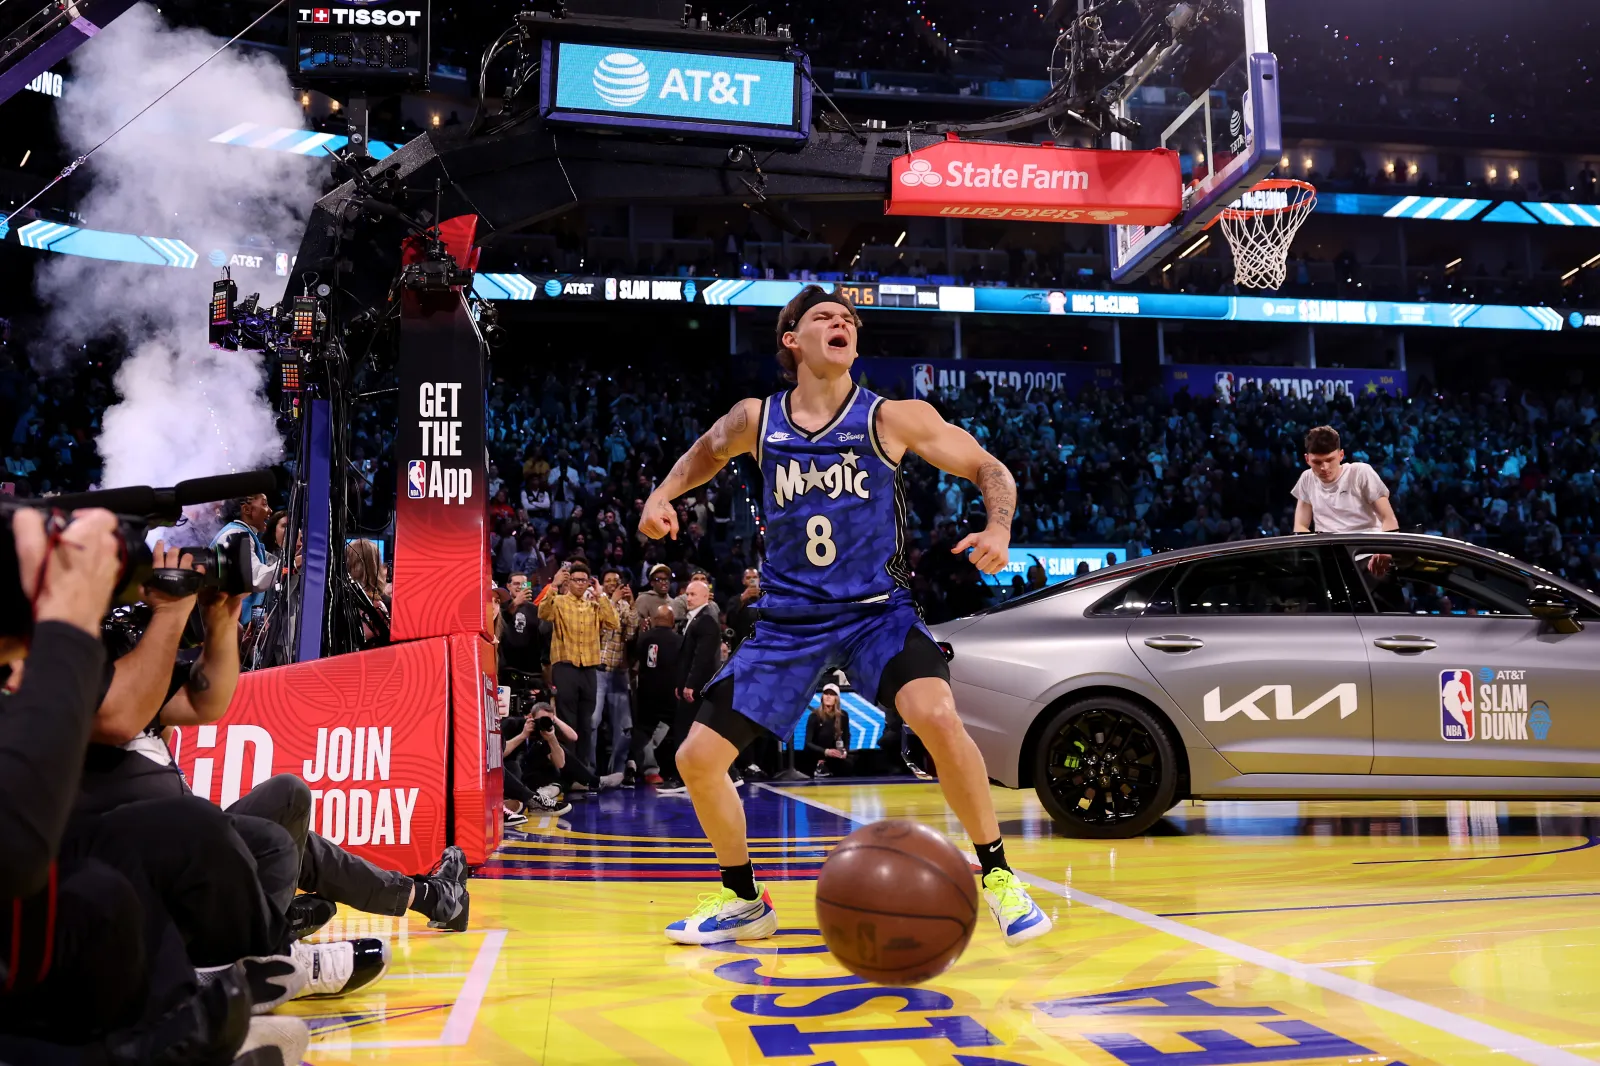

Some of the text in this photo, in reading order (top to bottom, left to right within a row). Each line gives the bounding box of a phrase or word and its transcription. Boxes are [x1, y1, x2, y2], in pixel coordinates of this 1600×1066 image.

[332, 8, 421, 26] TISSOT
[658, 68, 761, 106] AT&T
[229, 254, 264, 268] AT&T
[563, 282, 595, 295] AT&T
[619, 279, 650, 300] SLAM
[419, 381, 462, 418] GET
[418, 420, 463, 456] THE
[836, 432, 865, 442] Disney
[428, 460, 473, 504] App
[805, 514, 837, 567] 8
[1048, 557, 1075, 576] SLAM
[1496, 670, 1526, 680] AT&T
[1480, 684, 1528, 712] SLAM
[1445, 725, 1463, 737] NBA
[1480, 712, 1529, 740] DUNK
[302, 726, 392, 783] JOIN
